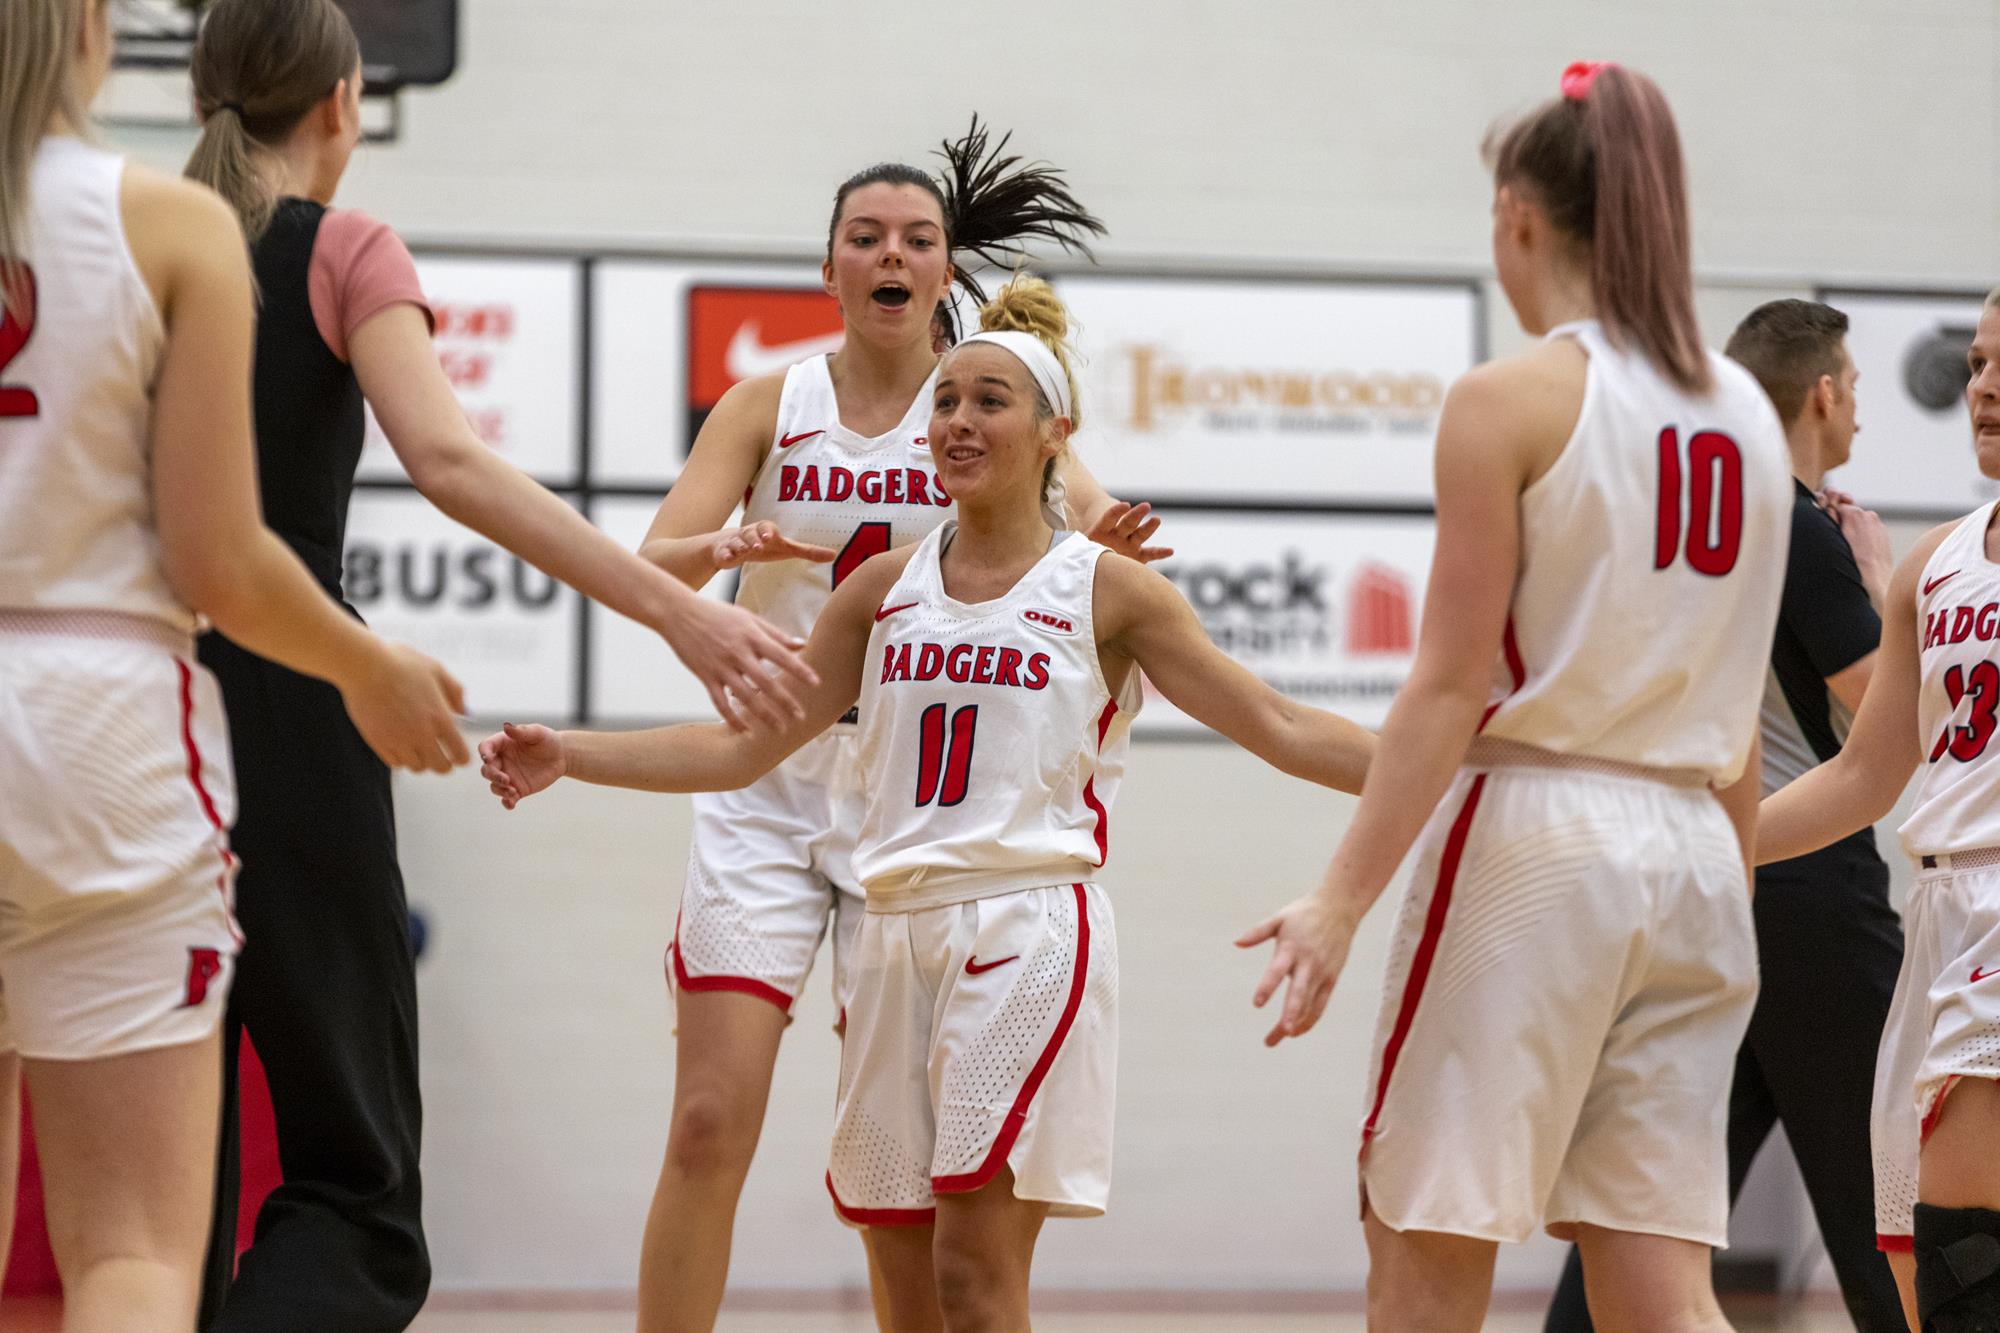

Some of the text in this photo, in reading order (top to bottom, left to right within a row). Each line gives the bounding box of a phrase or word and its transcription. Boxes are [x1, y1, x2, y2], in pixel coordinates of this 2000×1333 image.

[1130, 344, 1442, 432] IRONWOOD
[777, 465, 953, 507] BADGERS
[1654, 425, 1743, 577] 10
[345, 542, 561, 610] BUSU
[1024, 611, 1073, 632] OUA
[880, 643, 1051, 691] BADGERS
[1929, 659, 2000, 762] 13
[915, 702, 979, 808] 11
